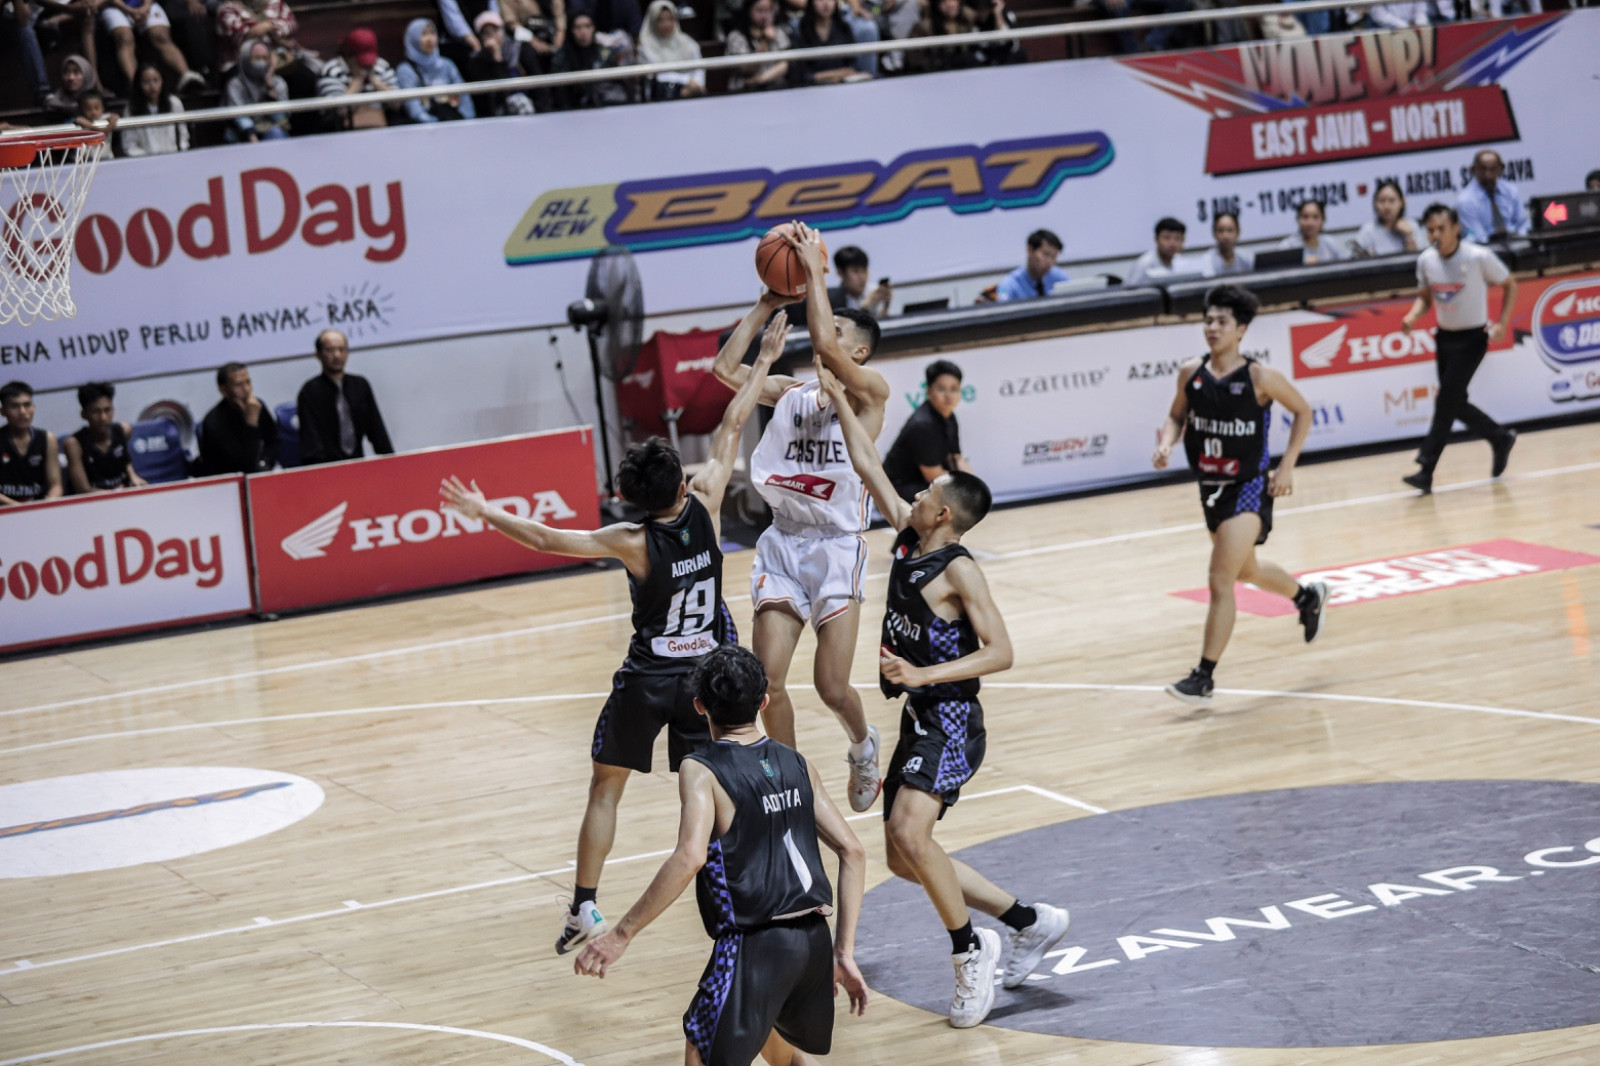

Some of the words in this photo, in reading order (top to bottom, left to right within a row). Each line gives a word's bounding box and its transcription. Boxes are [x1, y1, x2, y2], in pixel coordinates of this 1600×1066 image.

[1252, 116, 1309, 160] EAST
[1311, 110, 1370, 153] JAVA
[1390, 99, 1467, 143] NORTH
[540, 196, 590, 219] ALL
[1258, 190, 1275, 214] 11
[3, 176, 230, 281] Good
[240, 167, 408, 263] Day
[525, 216, 597, 242] NEW
[0, 339, 51, 366] ENA
[59, 327, 129, 360] HIDUP
[140, 320, 210, 350] PERLU
[221, 306, 312, 340] BANYAK
[327, 299, 382, 326] RASA
[1347, 326, 1438, 364] HON
[784, 439, 846, 465] CASTLE
[1204, 438, 1223, 459] 10
[114, 528, 224, 588] Day
[672, 550, 711, 578] ADRIAN
[663, 577, 716, 636] 19
[762, 788, 802, 815] ADITYA
[783, 828, 813, 893] 1
[994, 838, 1600, 986] ZAWEAR.C
